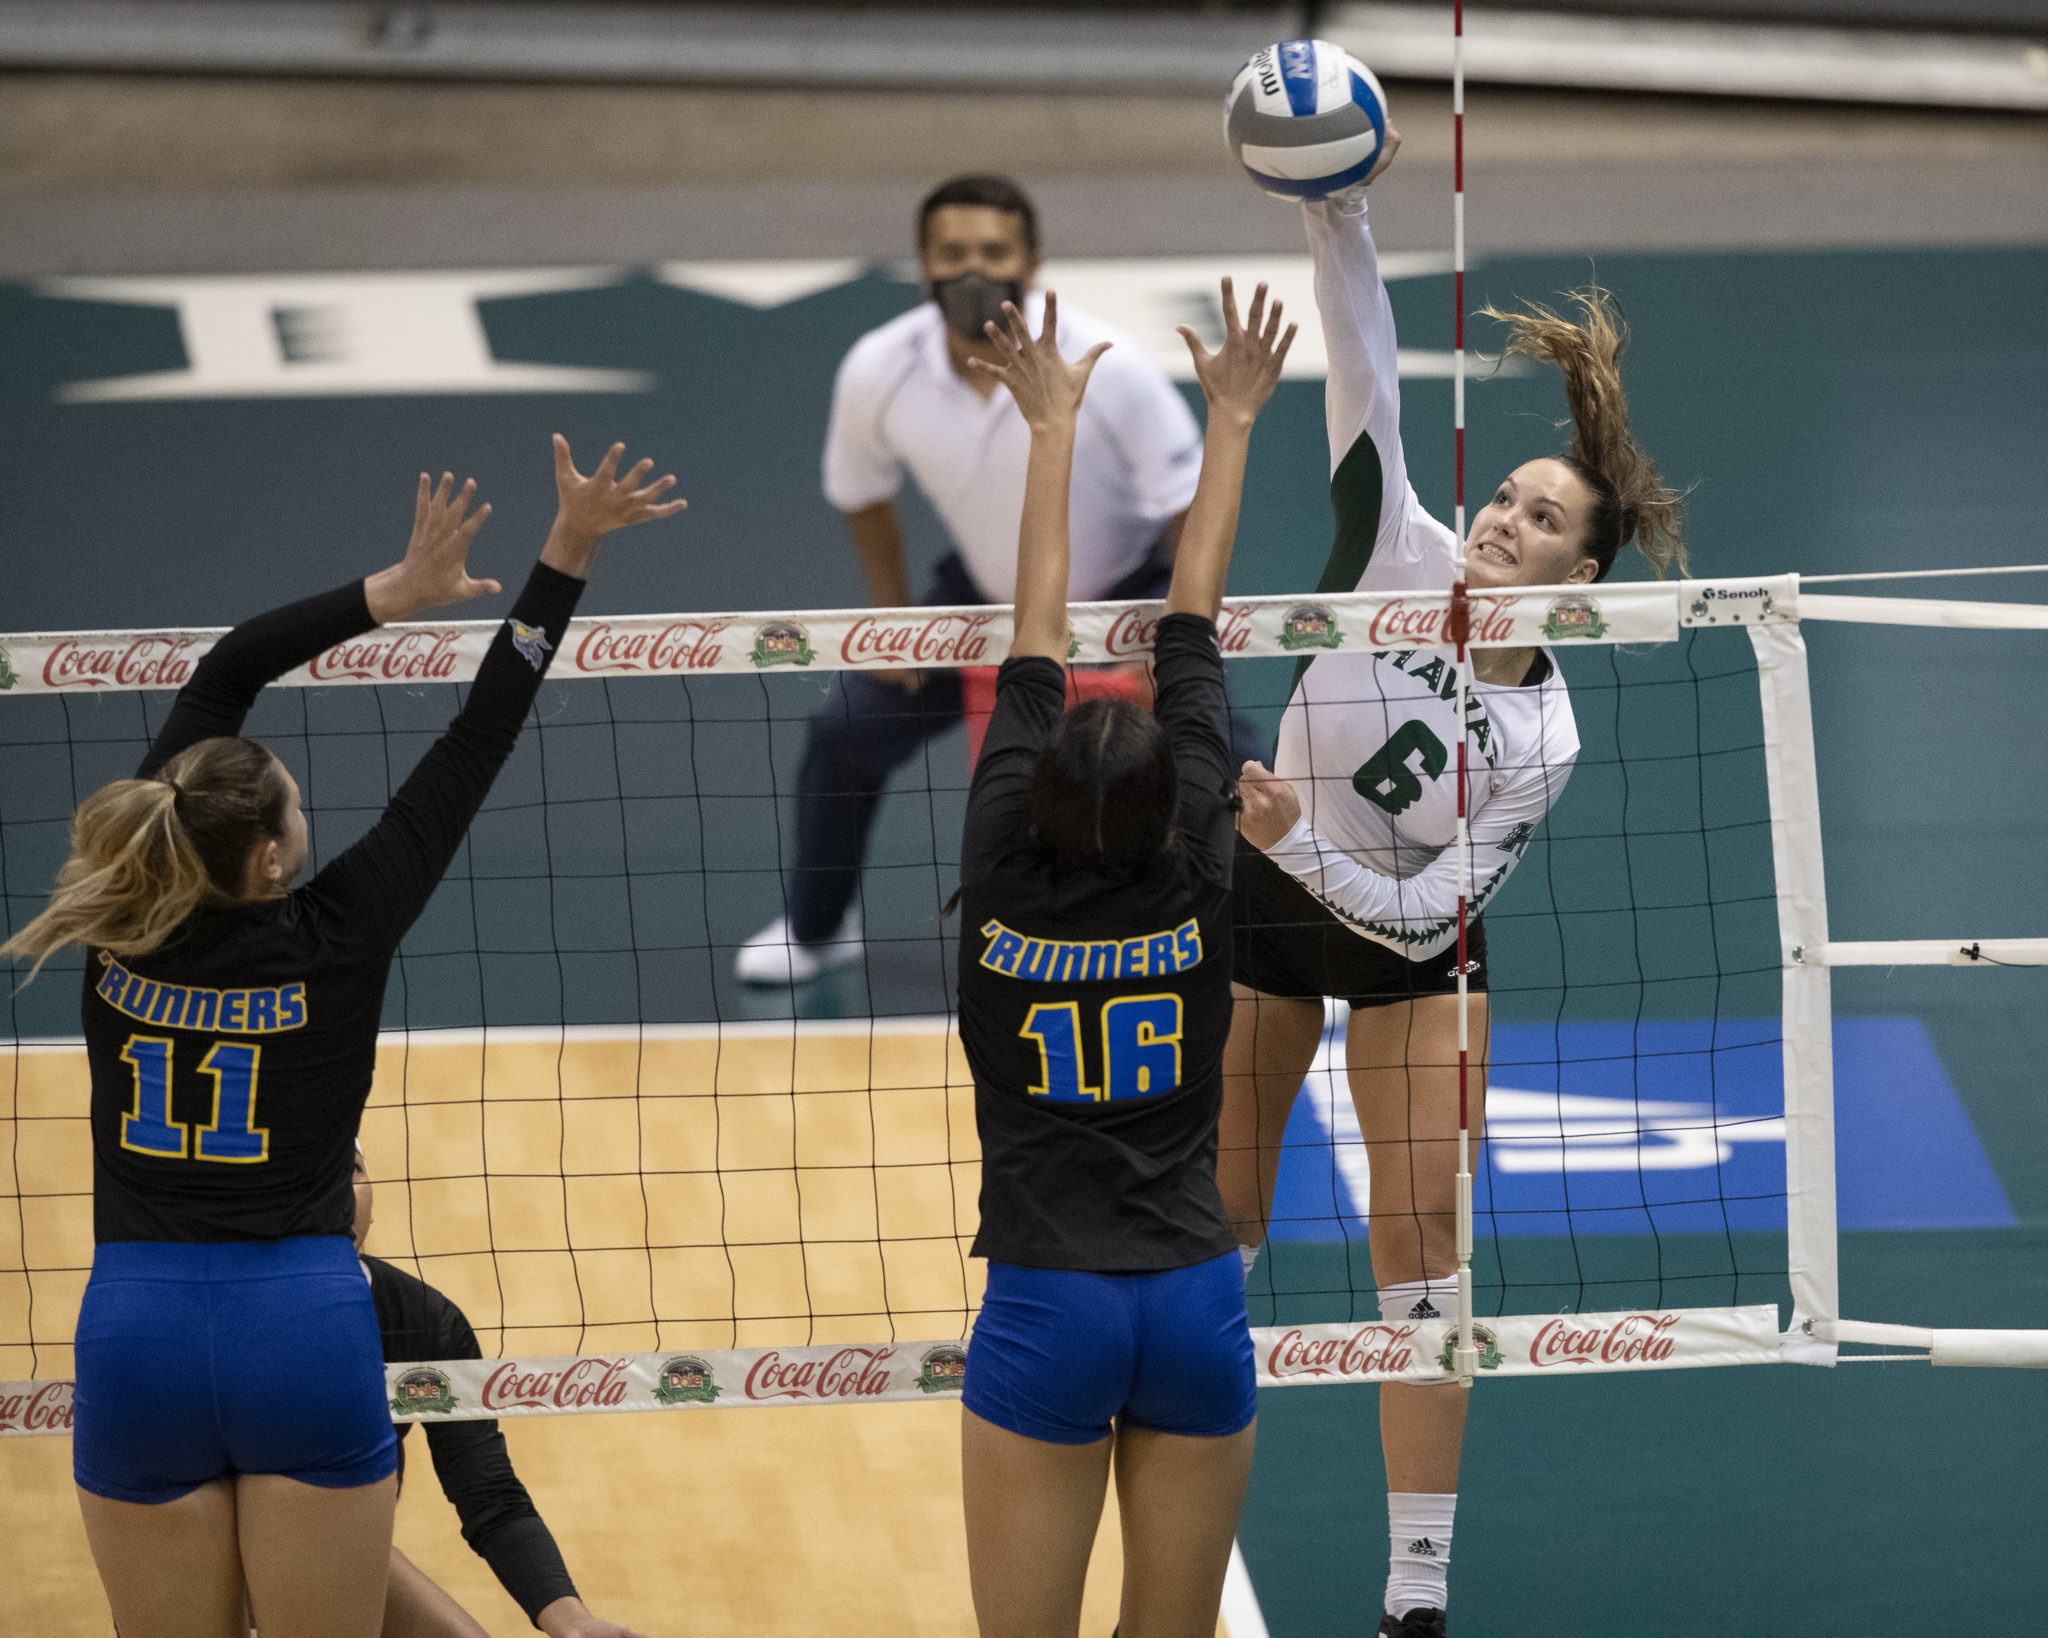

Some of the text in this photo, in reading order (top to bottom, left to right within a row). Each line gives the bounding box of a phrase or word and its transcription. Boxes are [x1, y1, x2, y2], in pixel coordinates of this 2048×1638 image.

[1717, 587, 1769, 600] Senoh
[42, 637, 199, 687] Coca-Cola
[575, 621, 729, 673] Coca-Cola
[840, 613, 998, 665] Coca-Cola
[1352, 718, 1448, 816] 6
[1447, 963, 1480, 976] adas
[1018, 992, 1183, 1103] 16
[119, 1033, 270, 1164] 11
[1408, 1310, 1441, 1320] adidas
[1529, 1314, 1682, 1368] Coca-Cola
[744, 1347, 898, 1400] Coca-Cola
[1268, 1324, 1421, 1378] Coca-Cola
[406, 1384, 440, 1399] Dole
[481, 1357, 635, 1411] Coca-Cola
[669, 1373, 703, 1388] Dole
[1407, 1546, 1437, 1557] adidas
